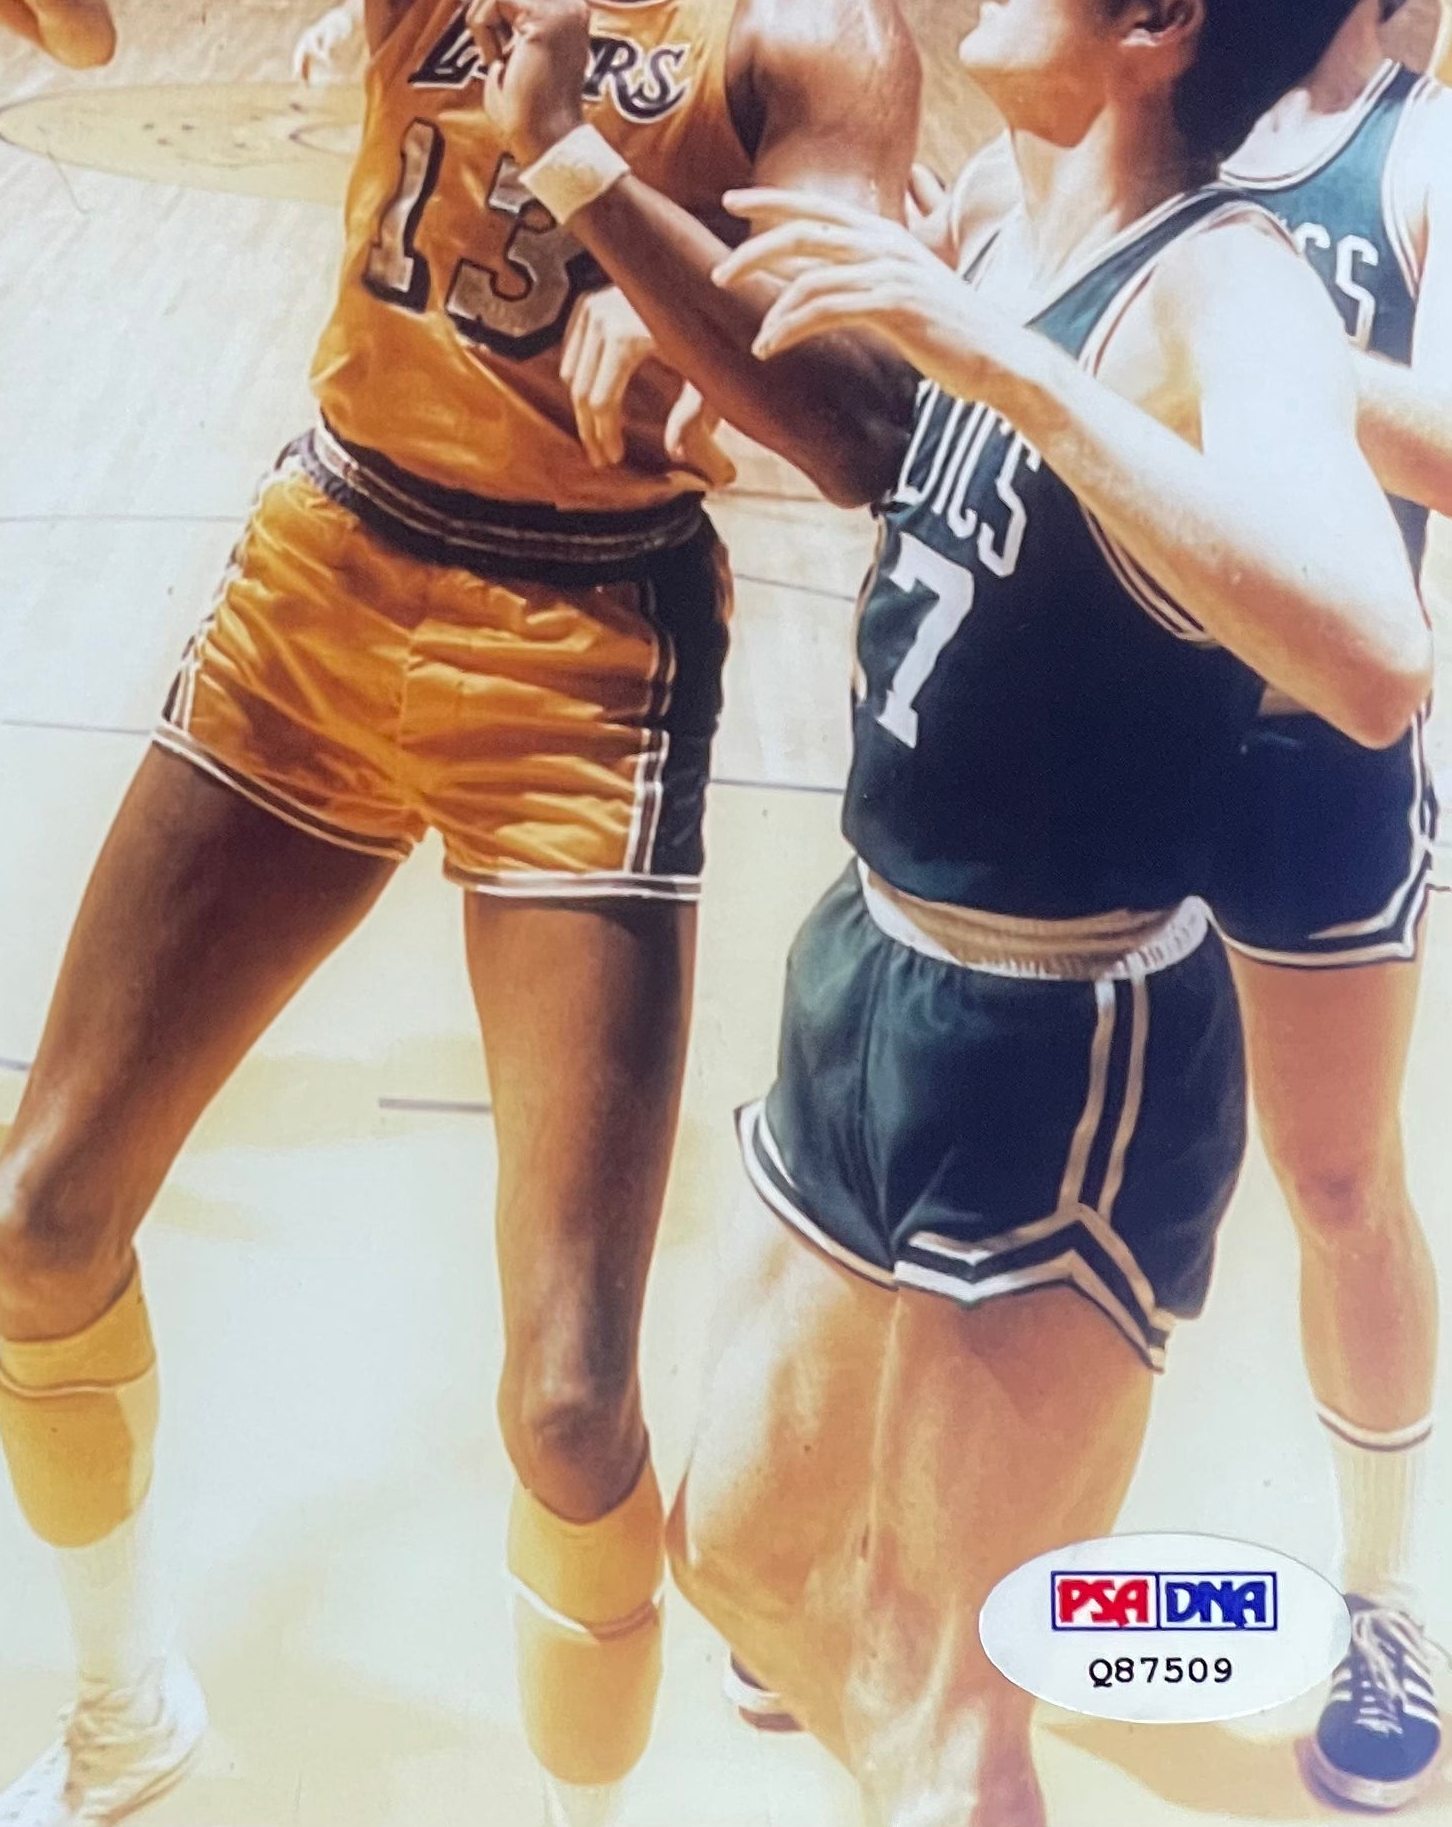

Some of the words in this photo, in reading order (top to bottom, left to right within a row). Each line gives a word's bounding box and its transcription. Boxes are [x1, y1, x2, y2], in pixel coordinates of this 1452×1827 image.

[1056, 1579, 1150, 1628] PSA
[1164, 1579, 1267, 1630] DNA
[1088, 1656, 1234, 1688] Q87509
